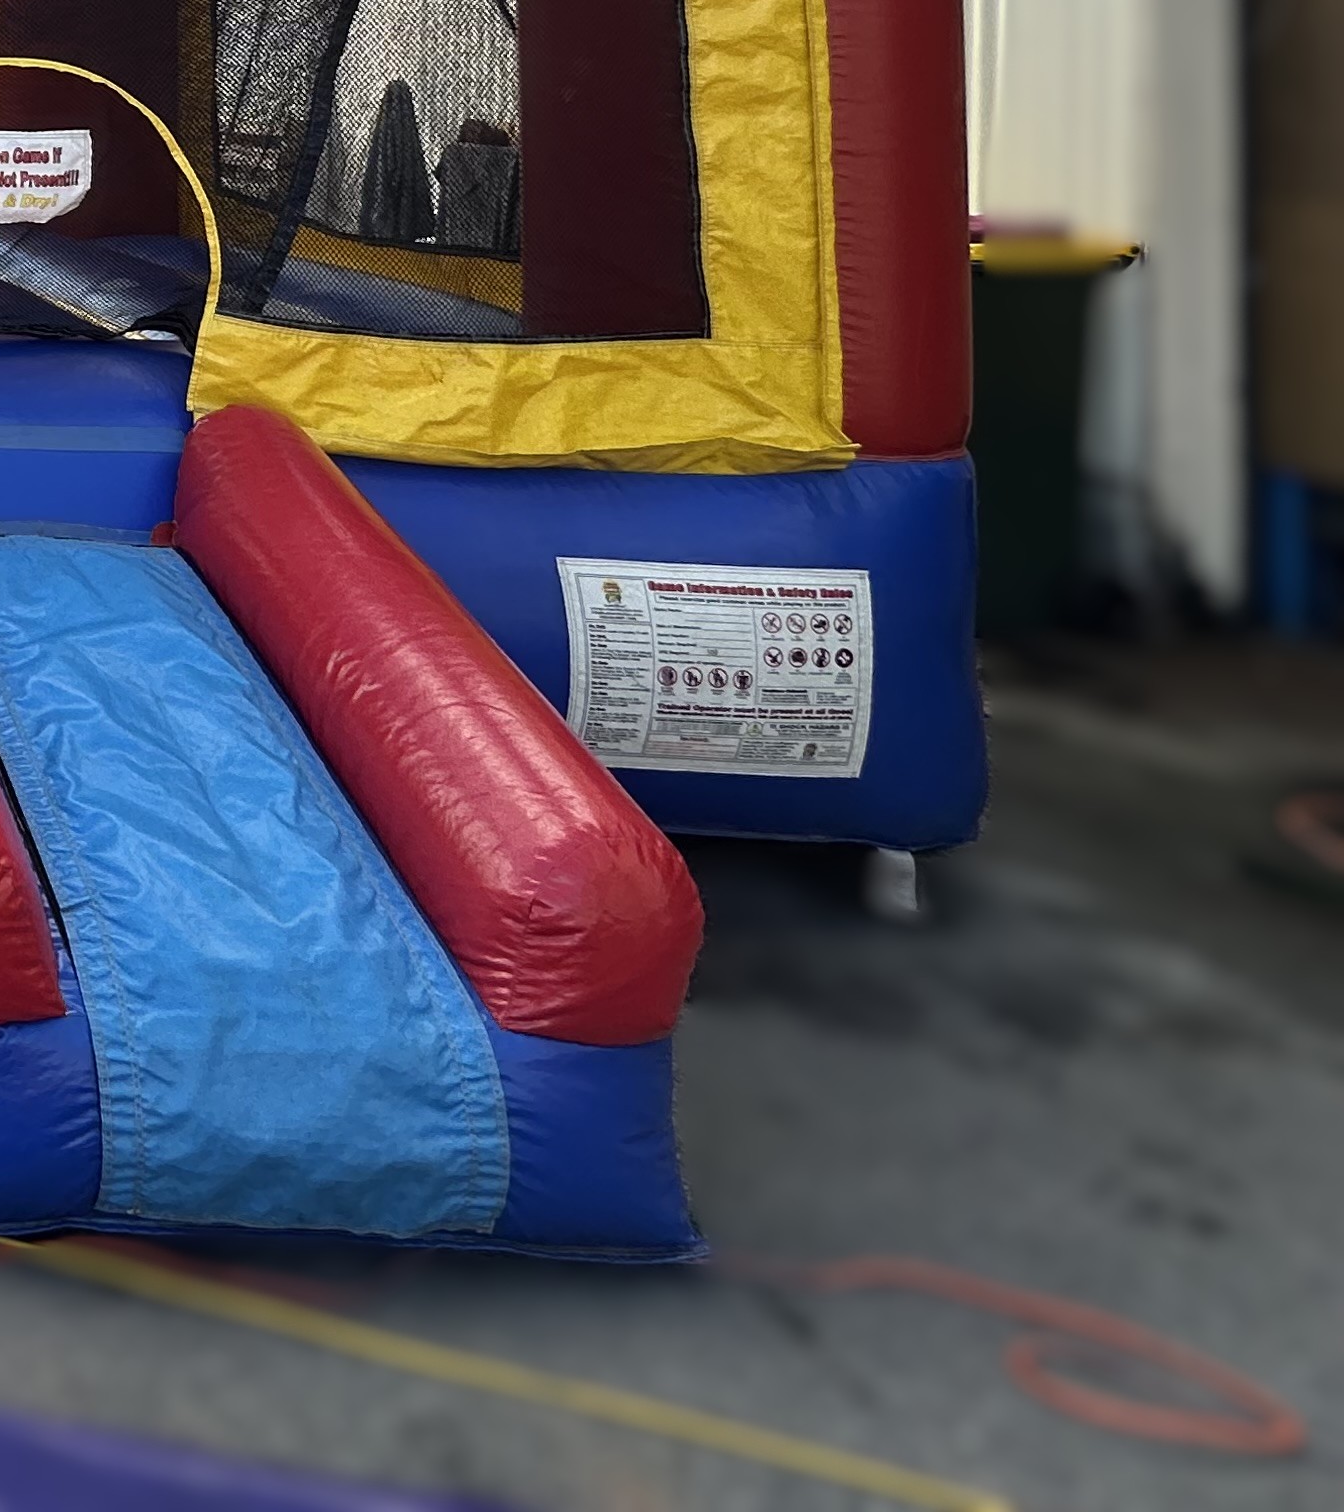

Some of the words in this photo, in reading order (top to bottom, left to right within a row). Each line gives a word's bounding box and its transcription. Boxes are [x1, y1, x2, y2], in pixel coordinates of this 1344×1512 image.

[13, 148, 49, 164] Game
[3, 193, 16, 207] &
[20, 193, 59, 209] Dry!
[687, 583, 764, 596] Information
[778, 587, 817, 598] Safety
